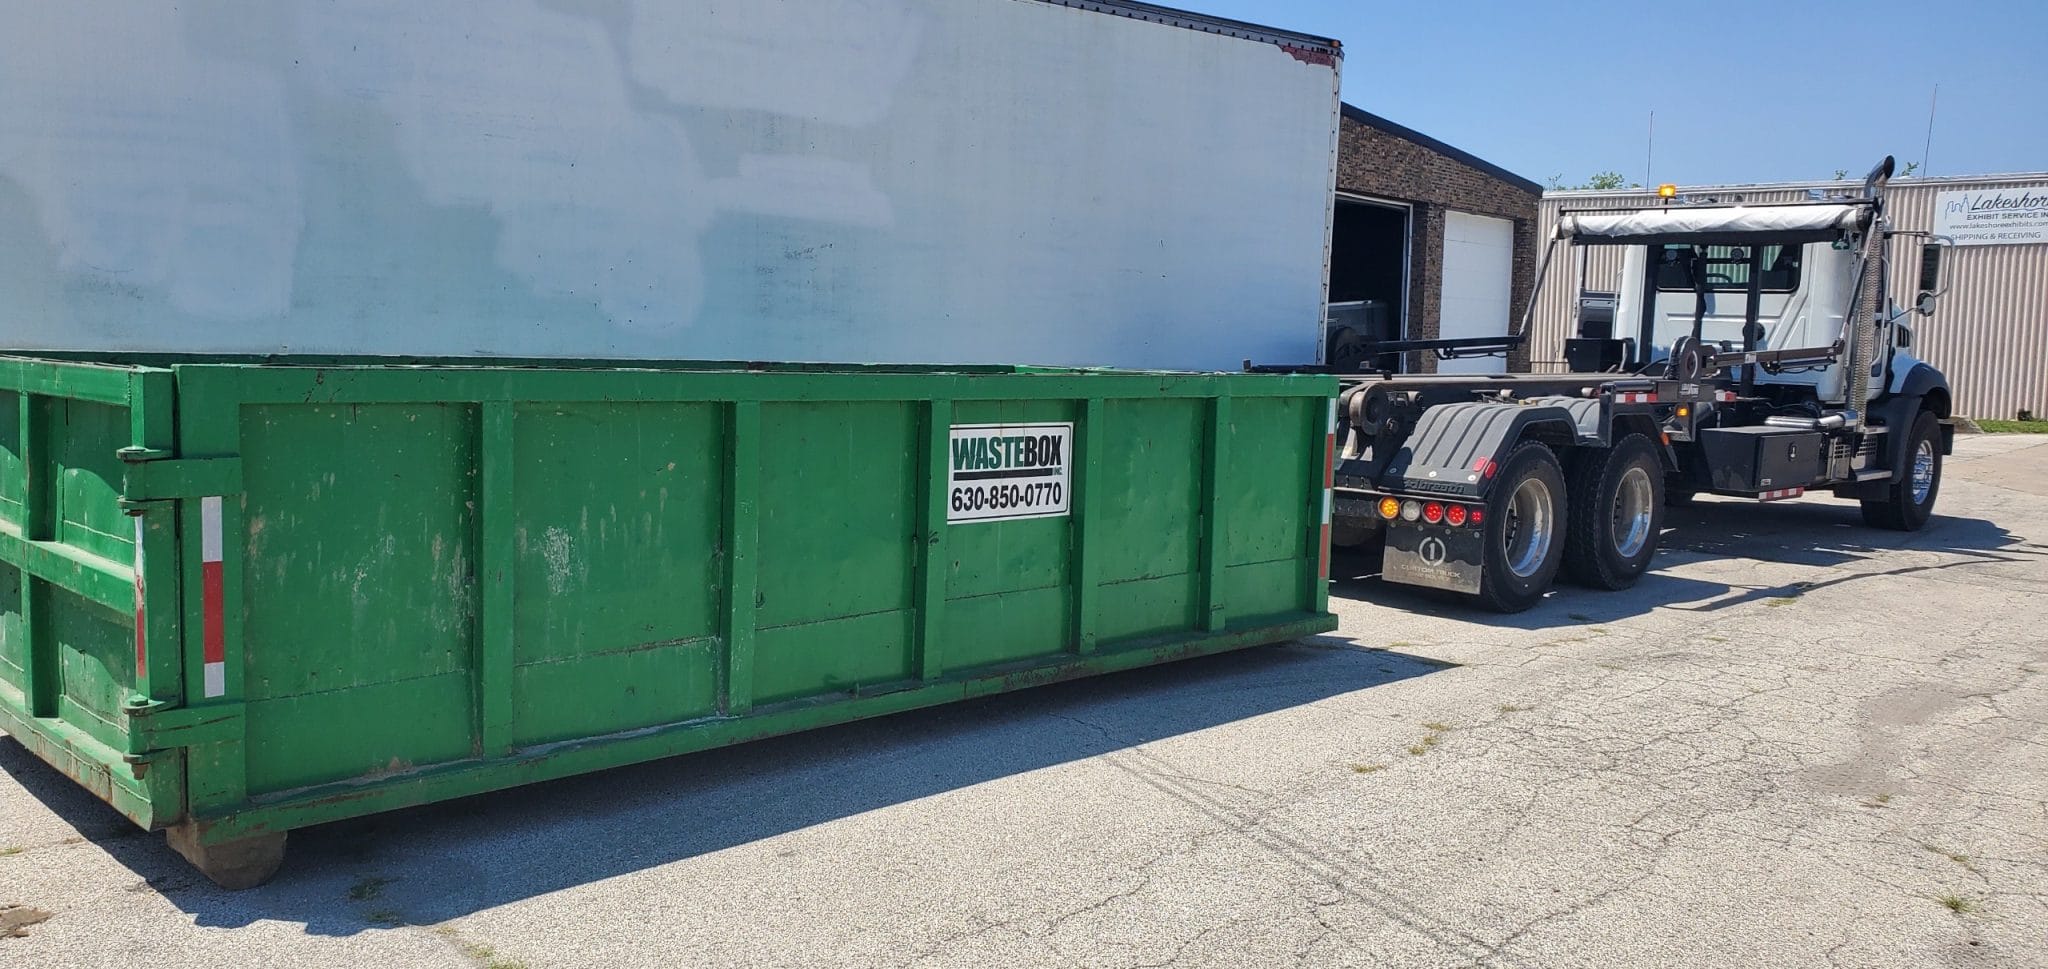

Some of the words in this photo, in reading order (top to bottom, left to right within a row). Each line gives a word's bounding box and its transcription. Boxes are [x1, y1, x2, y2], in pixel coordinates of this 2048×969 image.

[1971, 192, 2048, 210] Lakeshor
[2002, 211, 2039, 220] SERVICE
[1951, 232, 1988, 241] SHIPPING
[1998, 231, 2041, 239] RECEIVING
[952, 435, 1062, 470] WASTEBOX
[952, 482, 1062, 511] 630-850-0770
